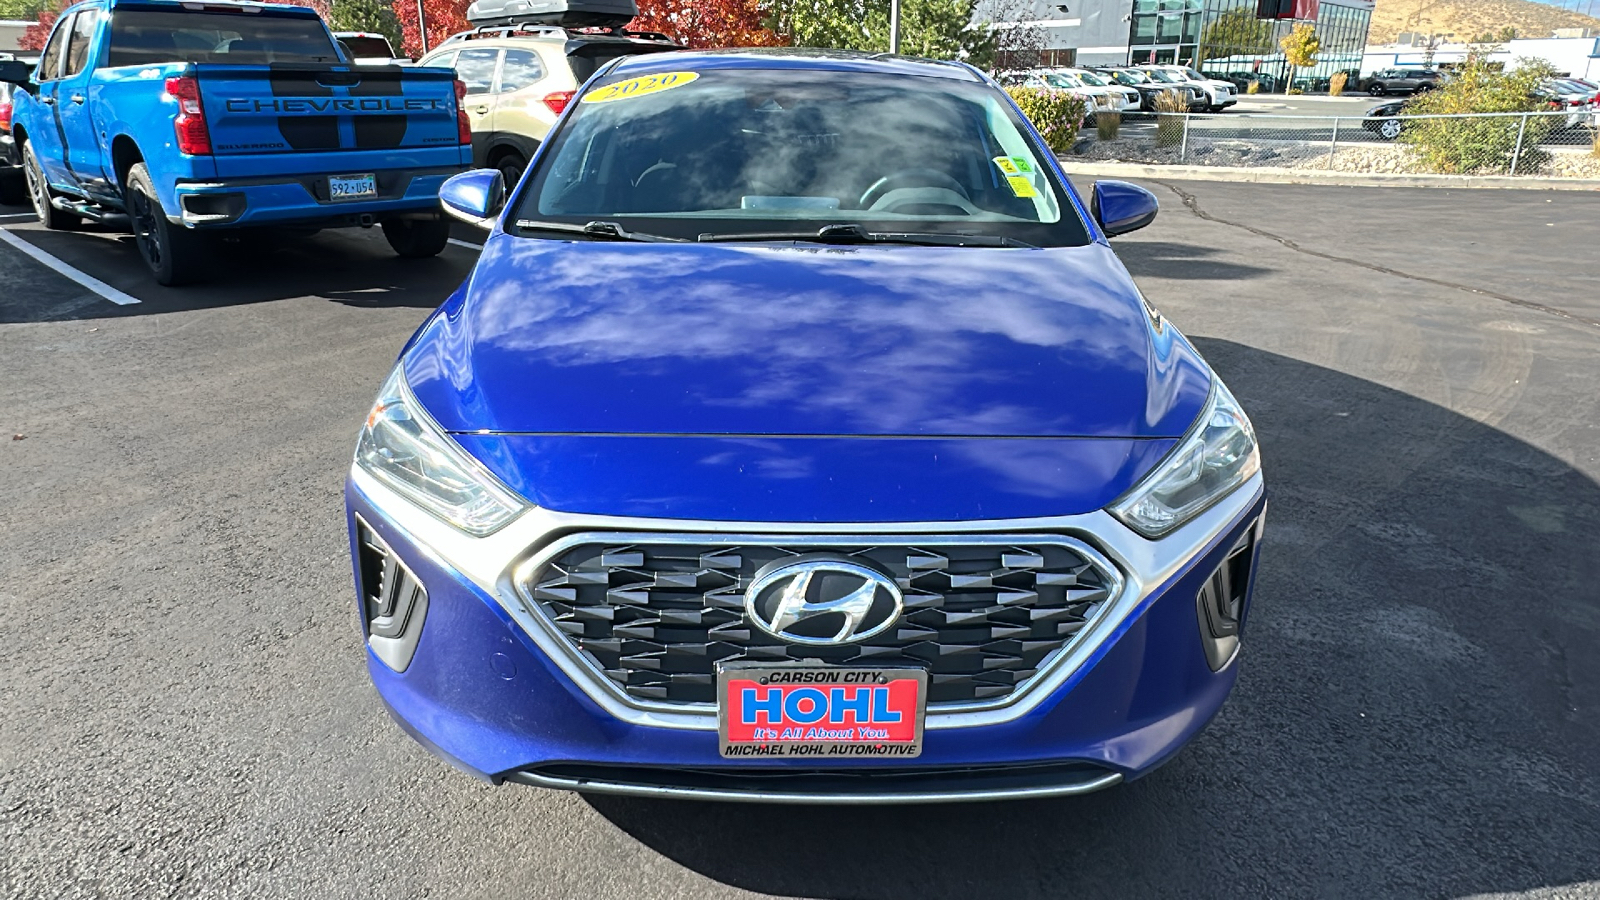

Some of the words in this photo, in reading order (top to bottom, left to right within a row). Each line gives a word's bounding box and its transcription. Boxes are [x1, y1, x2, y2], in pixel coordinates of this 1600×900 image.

[602, 75, 678, 100] 2020
[226, 99, 442, 112] CHEVROLET
[769, 671, 839, 683] CARSON
[843, 671, 883, 683] CITY
[741, 687, 902, 724] HOHL
[753, 726, 778, 739] It's
[779, 727, 803, 739] All
[804, 726, 853, 739] About
[725, 744, 786, 756] MICHAEL
[788, 744, 826, 756] HOHL
[828, 744, 917, 756] AUTOMOTIVE
